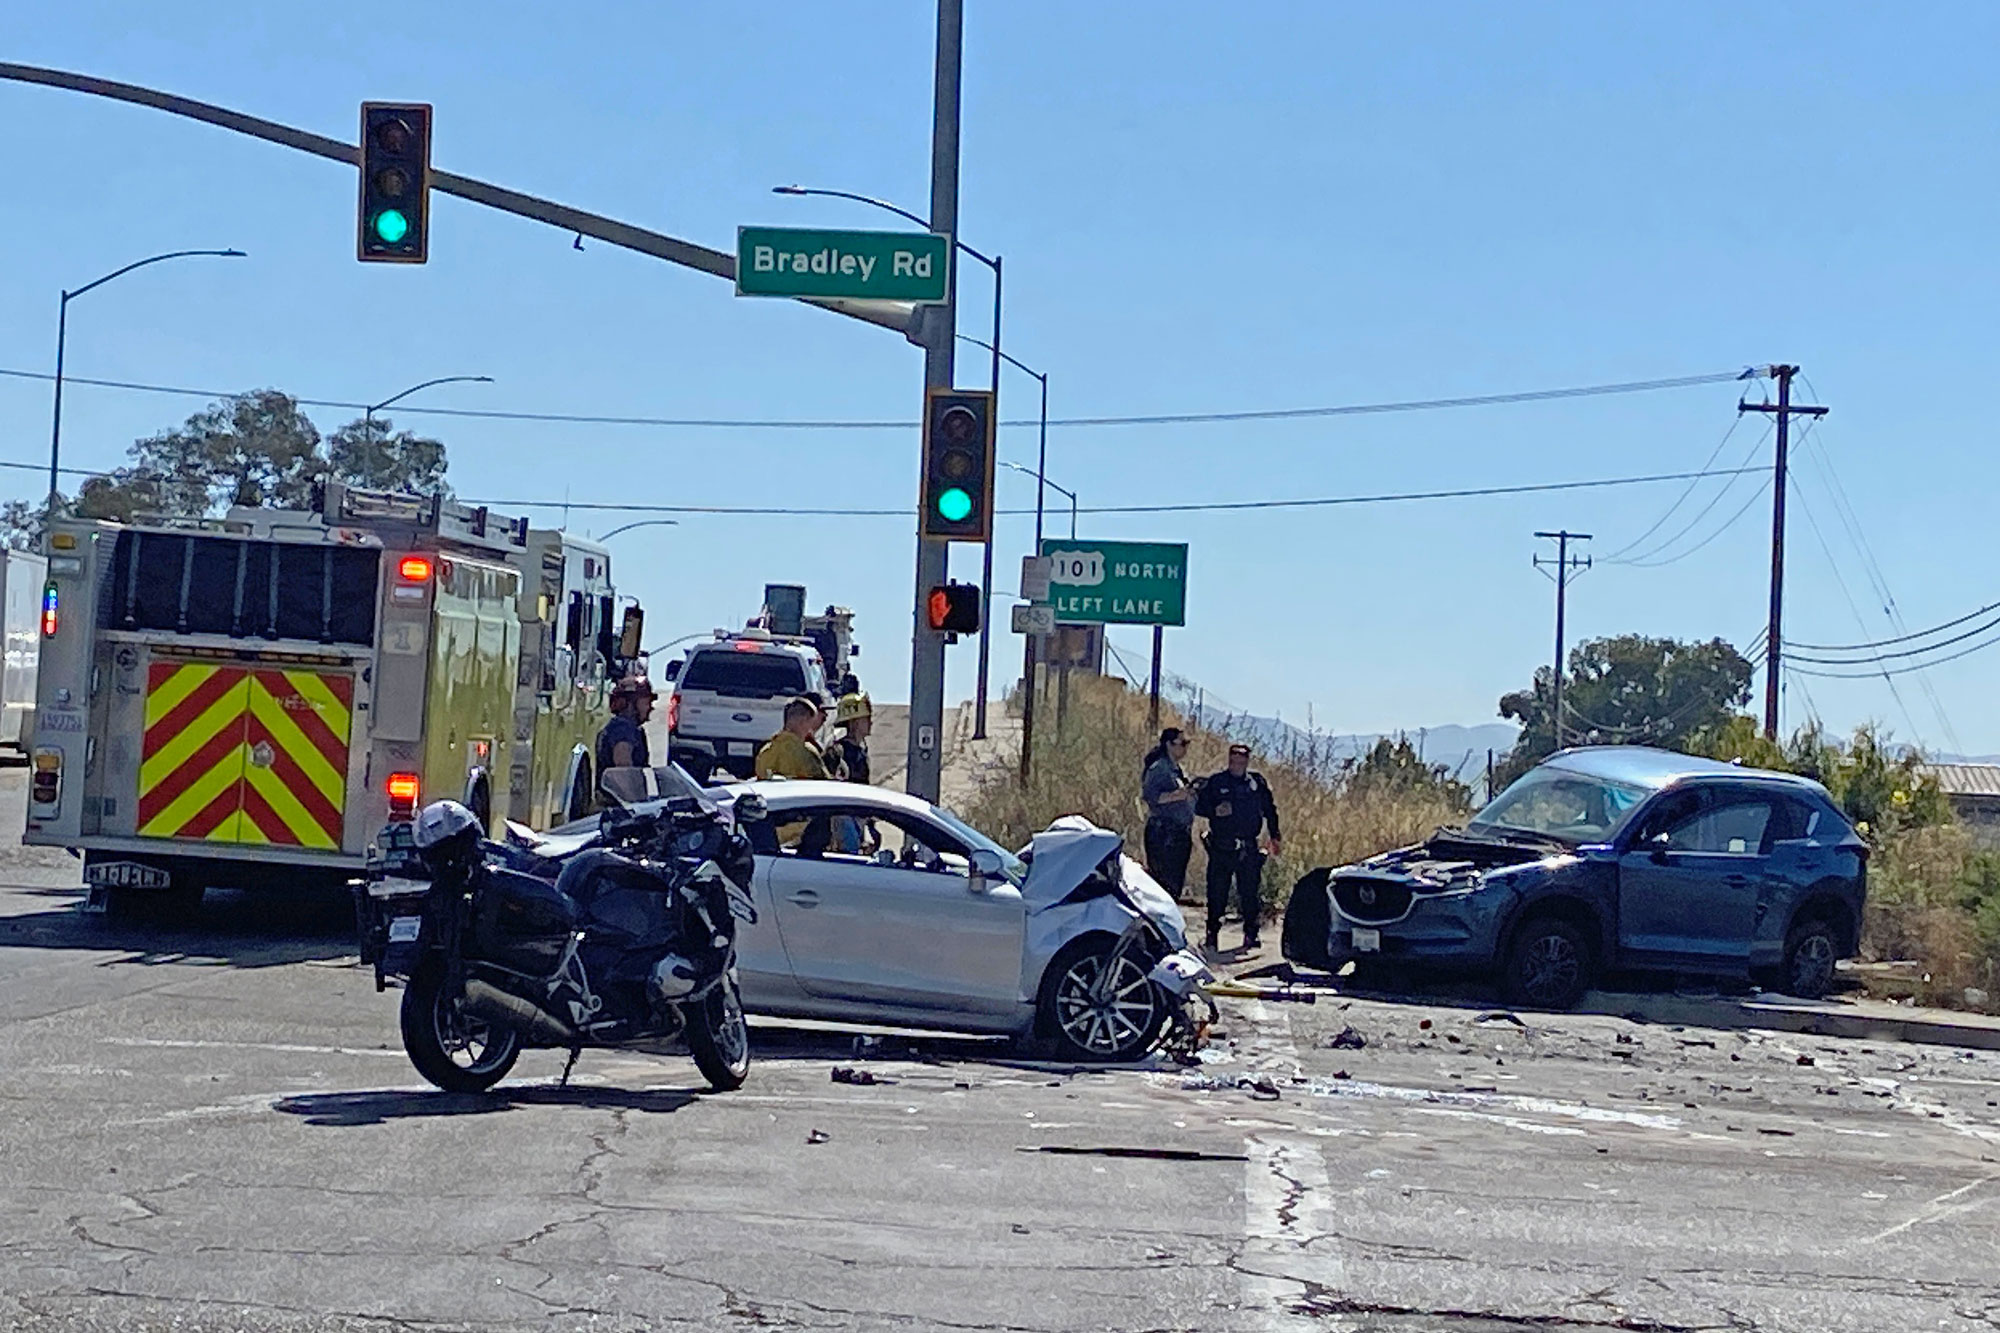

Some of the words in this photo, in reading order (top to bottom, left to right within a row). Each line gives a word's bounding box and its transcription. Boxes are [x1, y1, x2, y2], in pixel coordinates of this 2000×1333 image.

[754, 244, 876, 282] Bradley
[893, 249, 932, 278] Rd
[1059, 559, 1097, 577] 101
[1114, 562, 1179, 580] NORTH
[1057, 596, 1103, 613] LEFT
[1112, 598, 1164, 615] LANE
